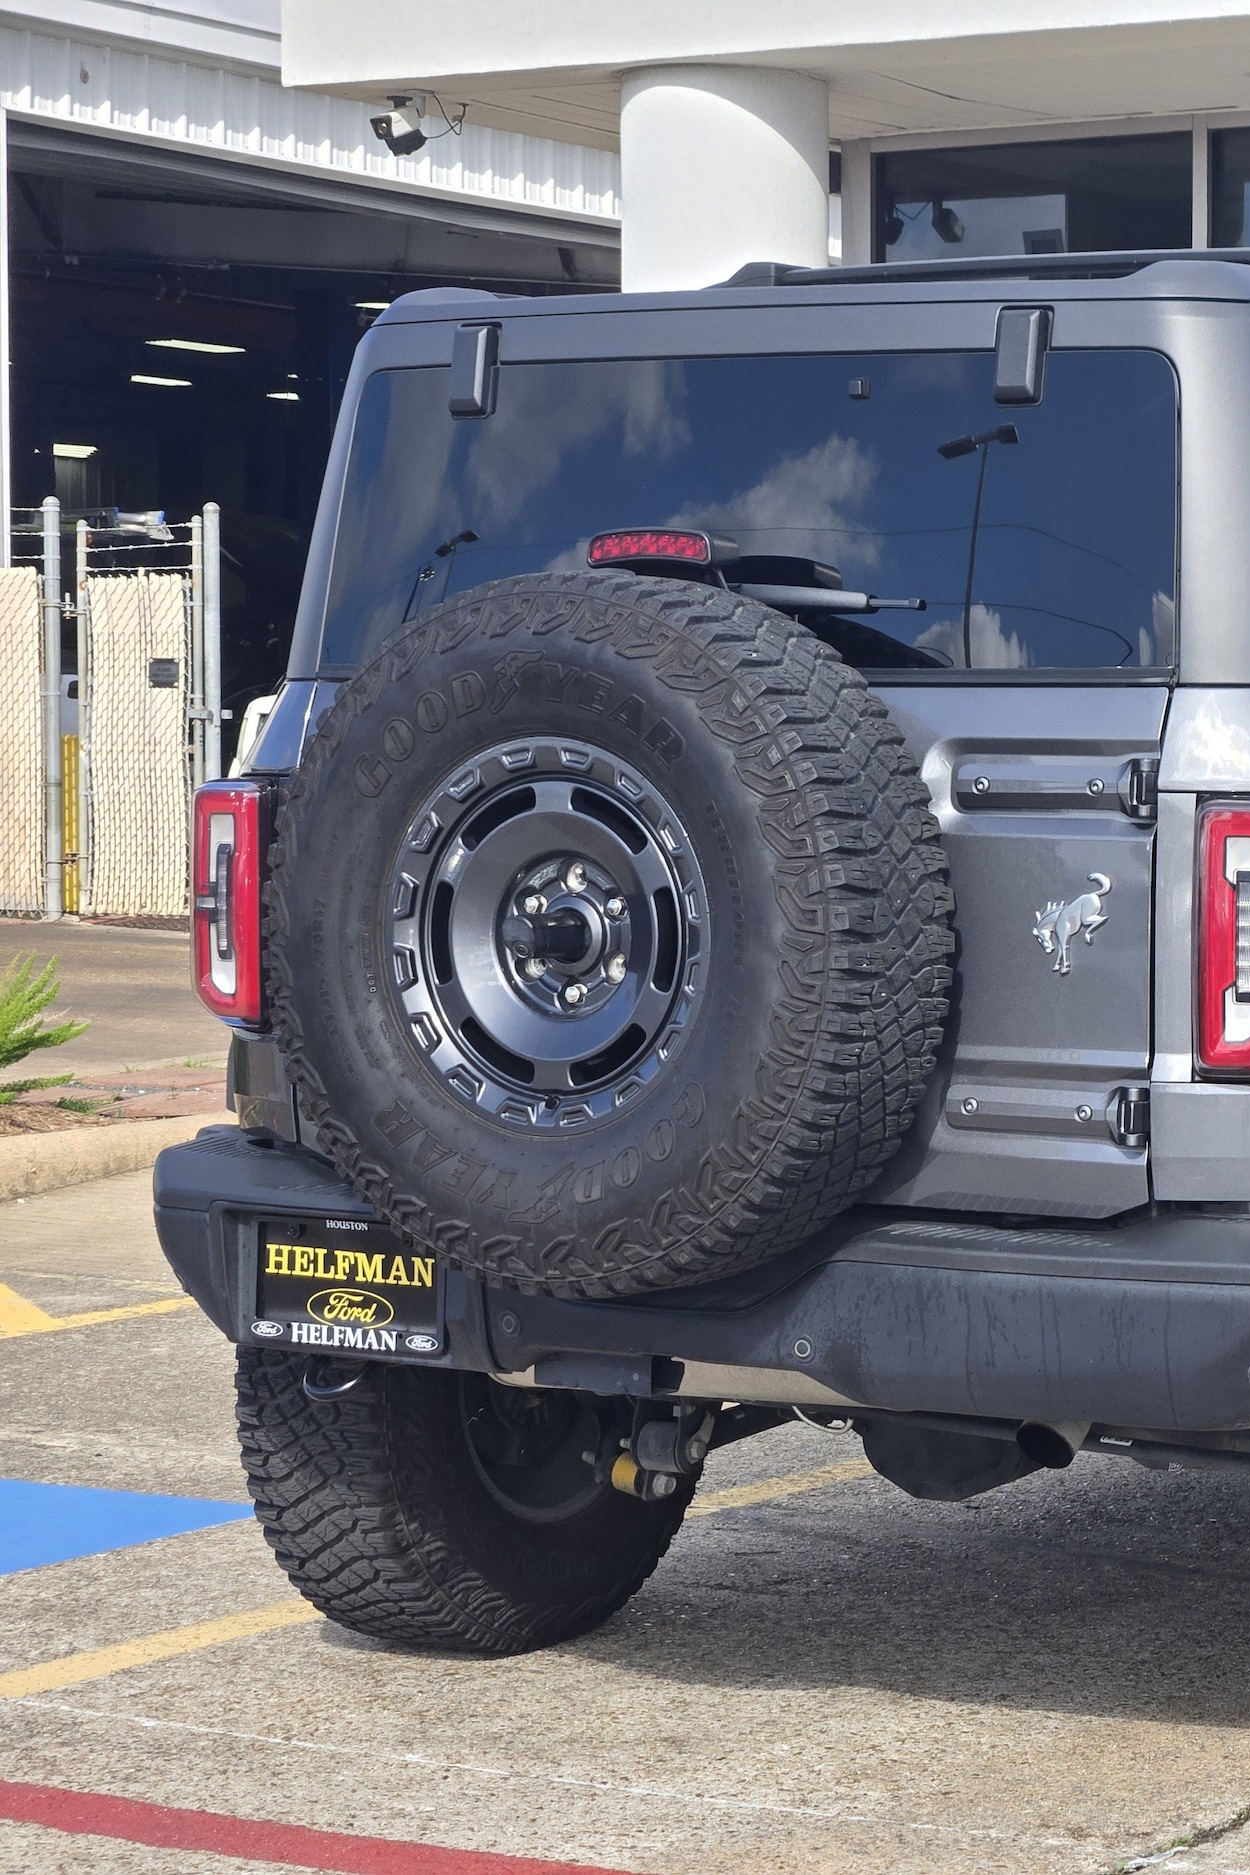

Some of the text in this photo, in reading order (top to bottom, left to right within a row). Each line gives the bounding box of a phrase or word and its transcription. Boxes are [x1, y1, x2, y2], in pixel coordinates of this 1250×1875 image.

[326, 1219, 368, 1231] HOUSTON
[265, 1243, 435, 1287] HELFMAN
[323, 1292, 378, 1323] Ford
[291, 1322, 397, 1352] HELFMAN
